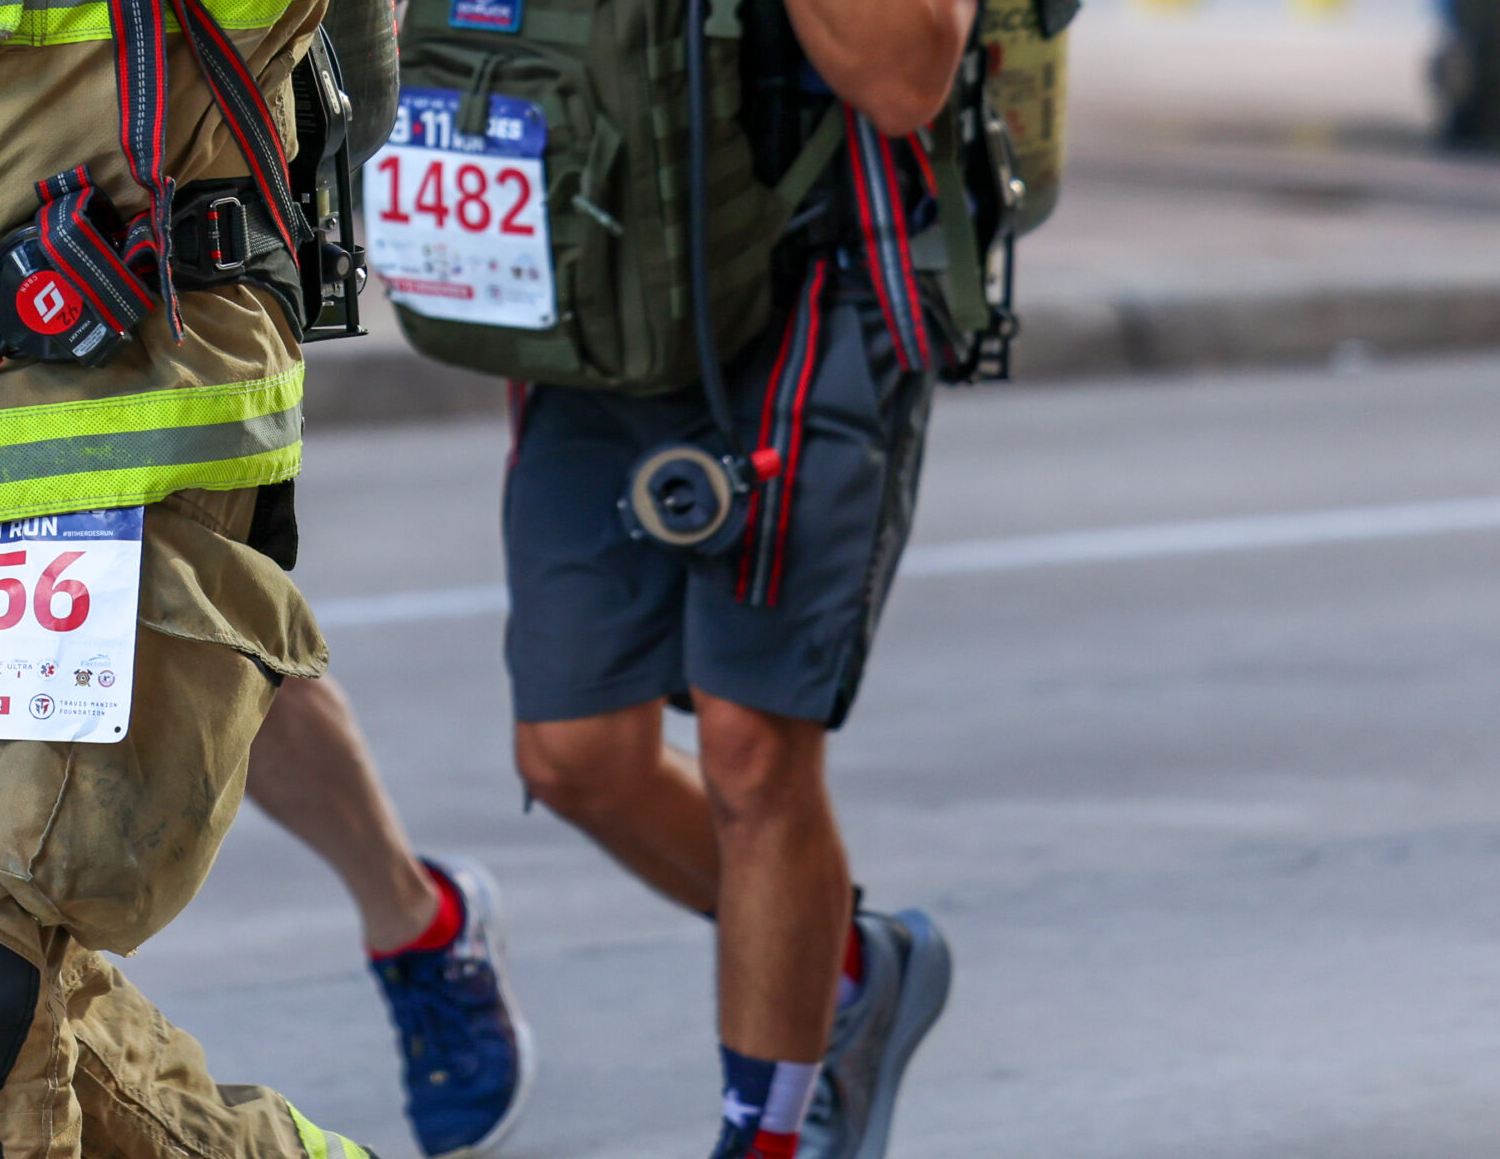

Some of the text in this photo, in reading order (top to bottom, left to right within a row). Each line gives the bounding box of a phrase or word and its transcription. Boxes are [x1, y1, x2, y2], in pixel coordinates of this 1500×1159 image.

[377, 155, 535, 236] 1482
[20, 275, 38, 293] CBRN
[9, 517, 58, 538] RUN
[60, 708, 105, 716] FOUNDATION
